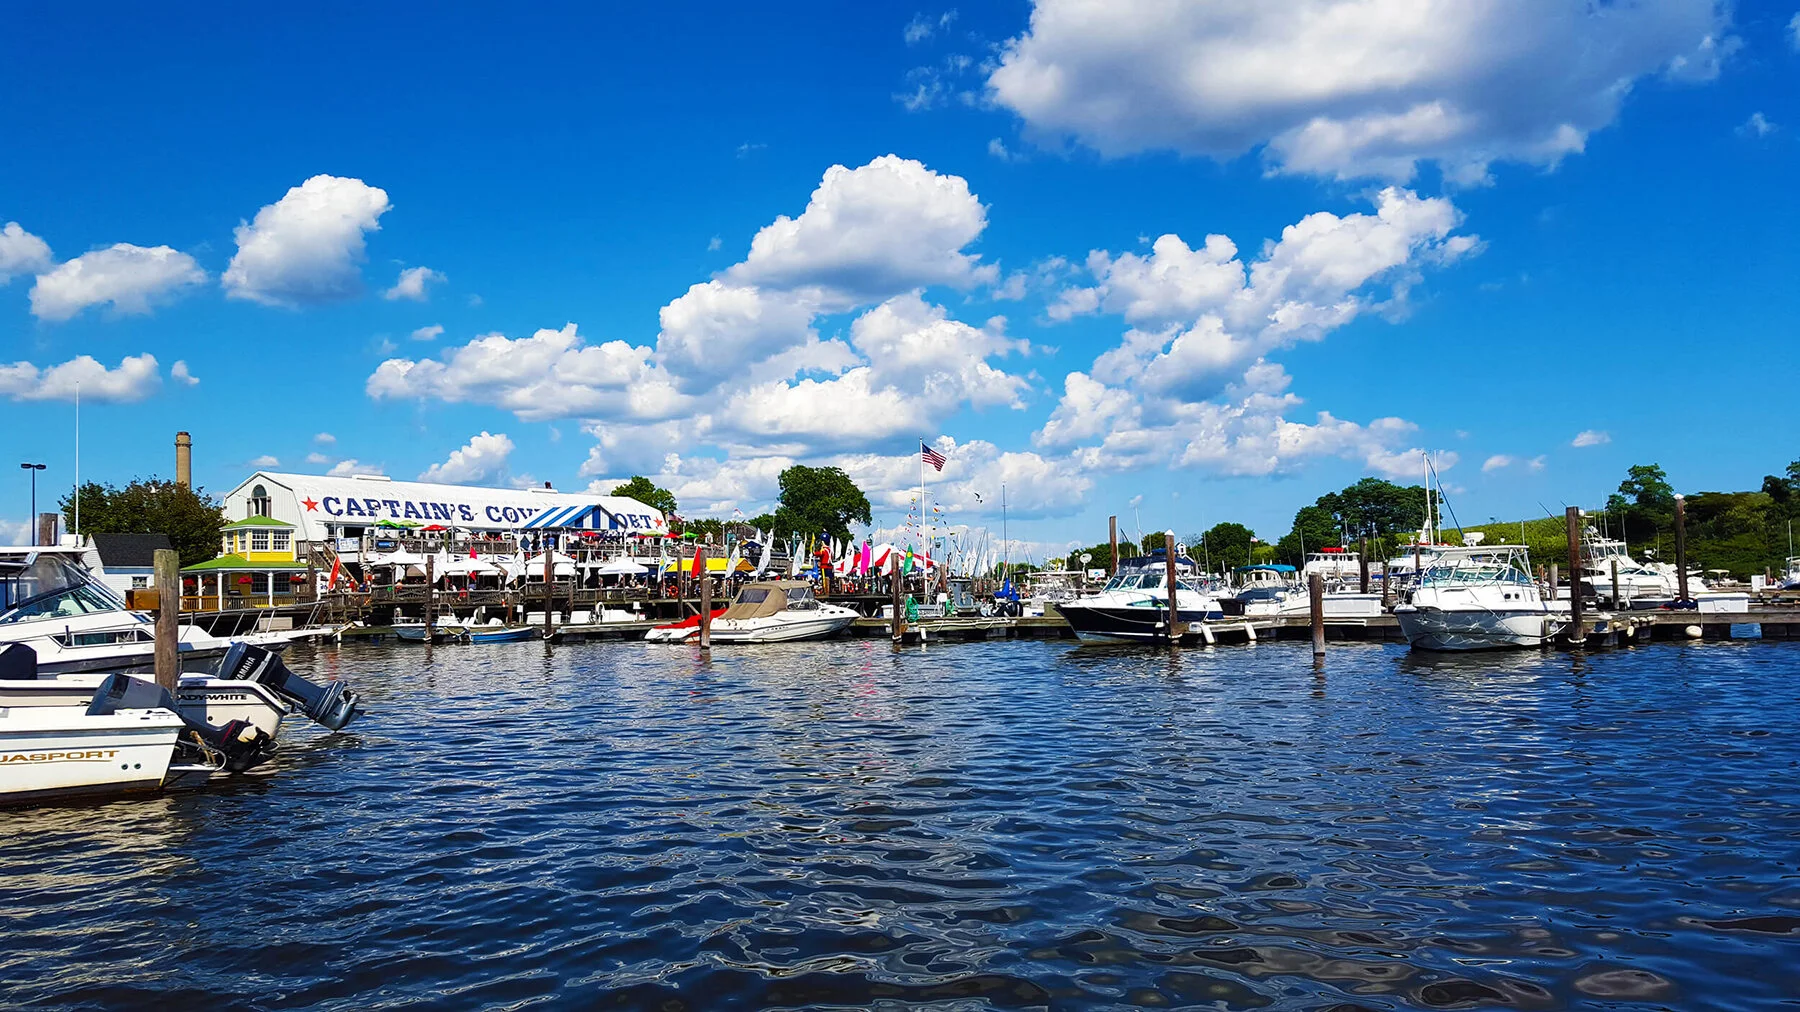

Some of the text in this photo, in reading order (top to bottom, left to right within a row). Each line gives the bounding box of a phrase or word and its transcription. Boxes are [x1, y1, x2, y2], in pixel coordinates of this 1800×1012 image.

[322, 496, 652, 529] CAPTAIN'S COV ORT
